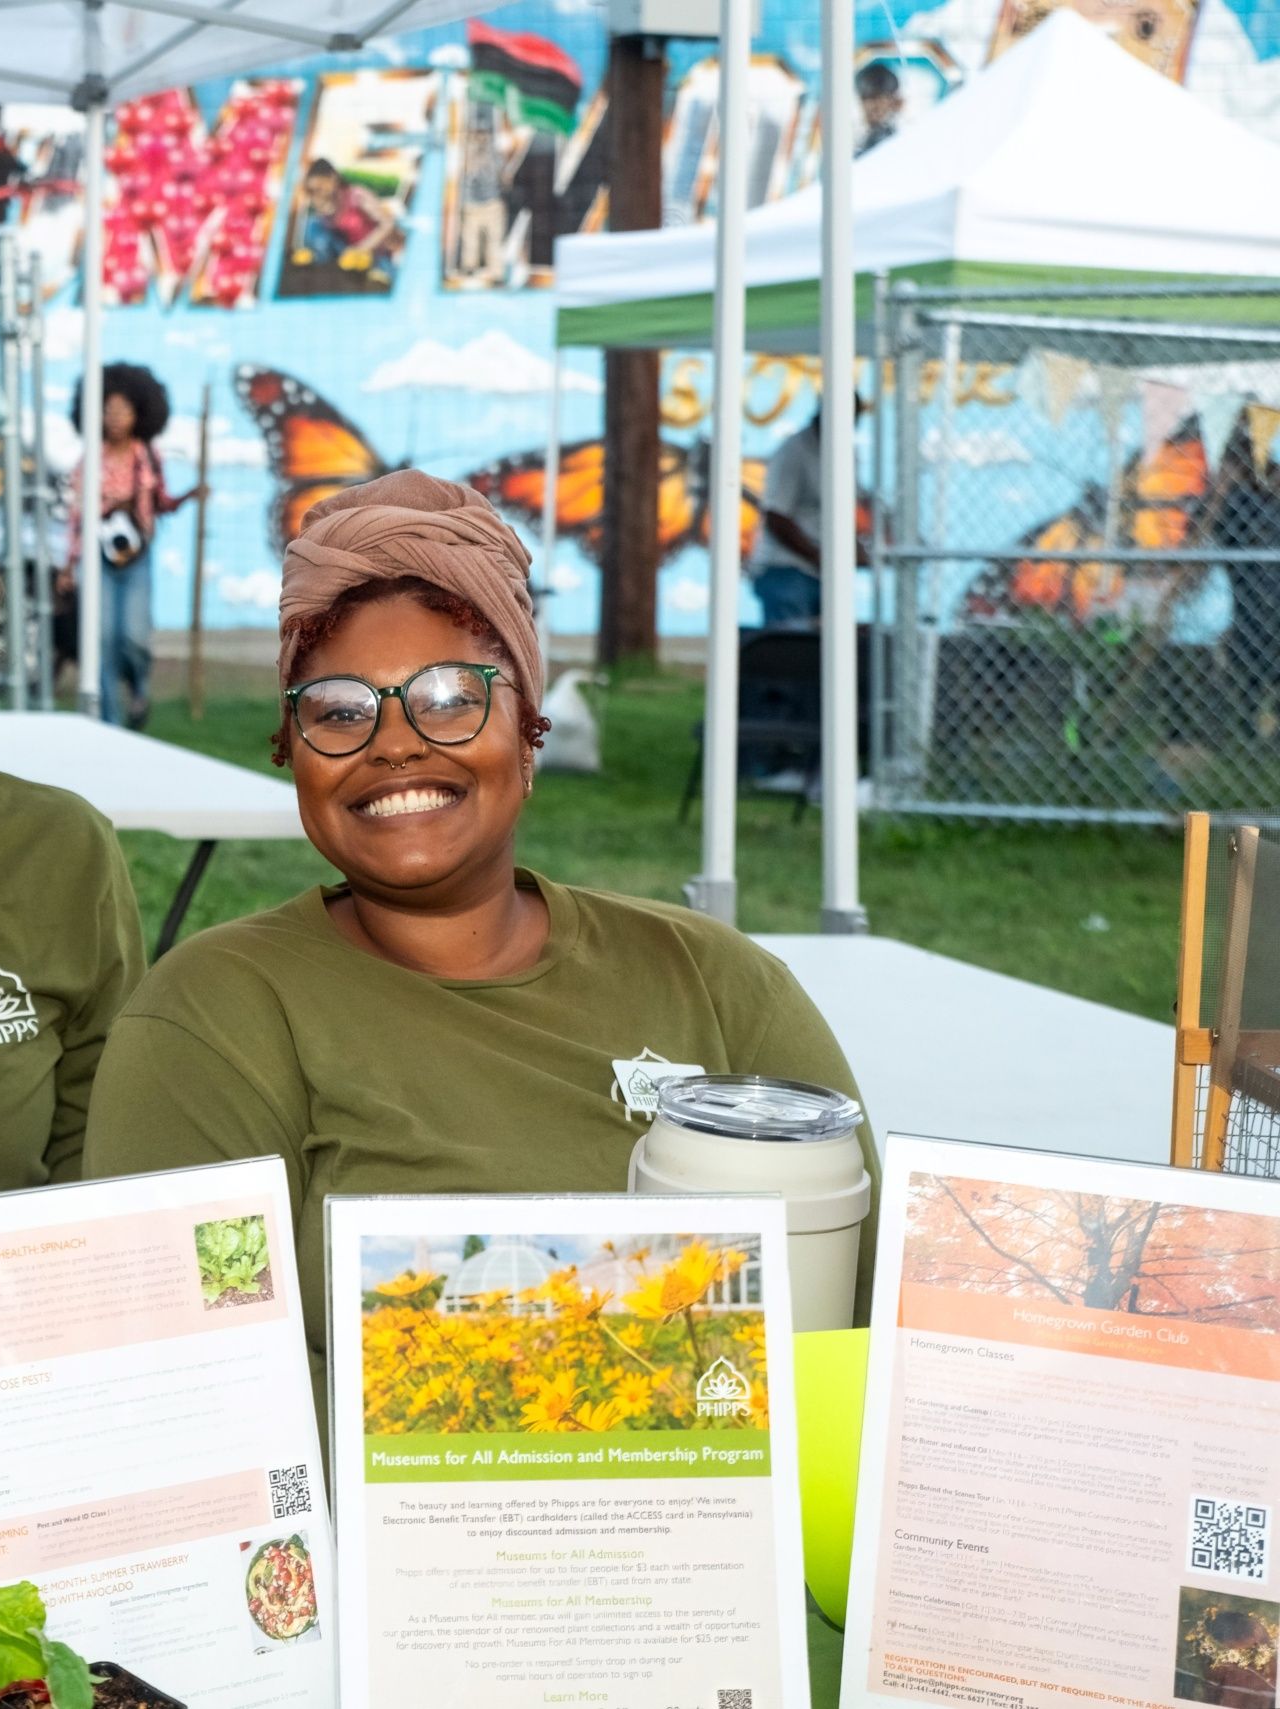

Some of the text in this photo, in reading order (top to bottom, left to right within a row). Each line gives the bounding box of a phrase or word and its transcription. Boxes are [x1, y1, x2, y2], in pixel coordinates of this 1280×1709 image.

[632, 1096, 658, 1107] PHIP
[40, 1237, 86, 1254] SPINACH
[1012, 1309, 1096, 1331] Homegrown
[1101, 1320, 1152, 1339] Garden
[1157, 1328, 1189, 1344] Club
[910, 1338, 1014, 1362] Homegrown Classes
[697, 1400, 752, 1417] PHIPPS
[372, 1445, 764, 1466] Museums for All Admission and Membership Program
[898, 1481, 991, 1501] Phipps Behind the Scenes Tour
[399, 1501, 415, 1510] The
[417, 1500, 447, 1511] beauty
[449, 1500, 465, 1509] and
[467, 1499, 502, 1510] learning
[504, 1499, 536, 1508] offered
[538, 1498, 548, 1509] by
[550, 1498, 579, 1509] Phipps
[597, 1497, 611, 1506] for
[613, 1499, 653, 1508] everyone
[655, 1497, 665, 1505] to
[695, 1496, 710, 1504] We
[712, 1496, 736, 1504] invite
[64, 1516, 80, 1524] Weed
[82, 1512, 89, 1520] ID
[382, 1509, 753, 1524] Electronic Benefit Transfer (EBT) cardholders (called the ACCESS card in Pennsylvania)
[479, 1530, 502, 1538] enjoy
[504, 1527, 552, 1536] discounted
[554, 1526, 597, 1535] admission
[599, 1526, 615, 1534] and
[894, 1529, 989, 1554] Community Events
[496, 1547, 644, 1560] Museums for All Admission
[90, 1567, 128, 1583] SUMMER
[129, 1554, 189, 1574] STRAWBERRY
[59, 1590, 84, 1604] WITH
[86, 1581, 134, 1598] AVOCADO
[491, 1594, 652, 1607] Museums for All Membership
[889, 1589, 960, 1607] Halloween Celebration
[884, 1671, 906, 1679] Email:
[897, 1664, 912, 1672] ASK
[885, 1653, 946, 1670] REGISTRATION
[1040, 1682, 1059, 1691] NOT
[1061, 1686, 1105, 1699] REQUIRED
[1107, 1694, 1124, 1703] FOR
[1126, 1698, 1144, 1707] THE
[543, 1689, 607, 1701] Learn More
[883, 1680, 899, 1688] Call:
[952, 1690, 965, 1700] ext.
[967, 1694, 984, 1703] 6627
[991, 1700, 1008, 1708] Text:
